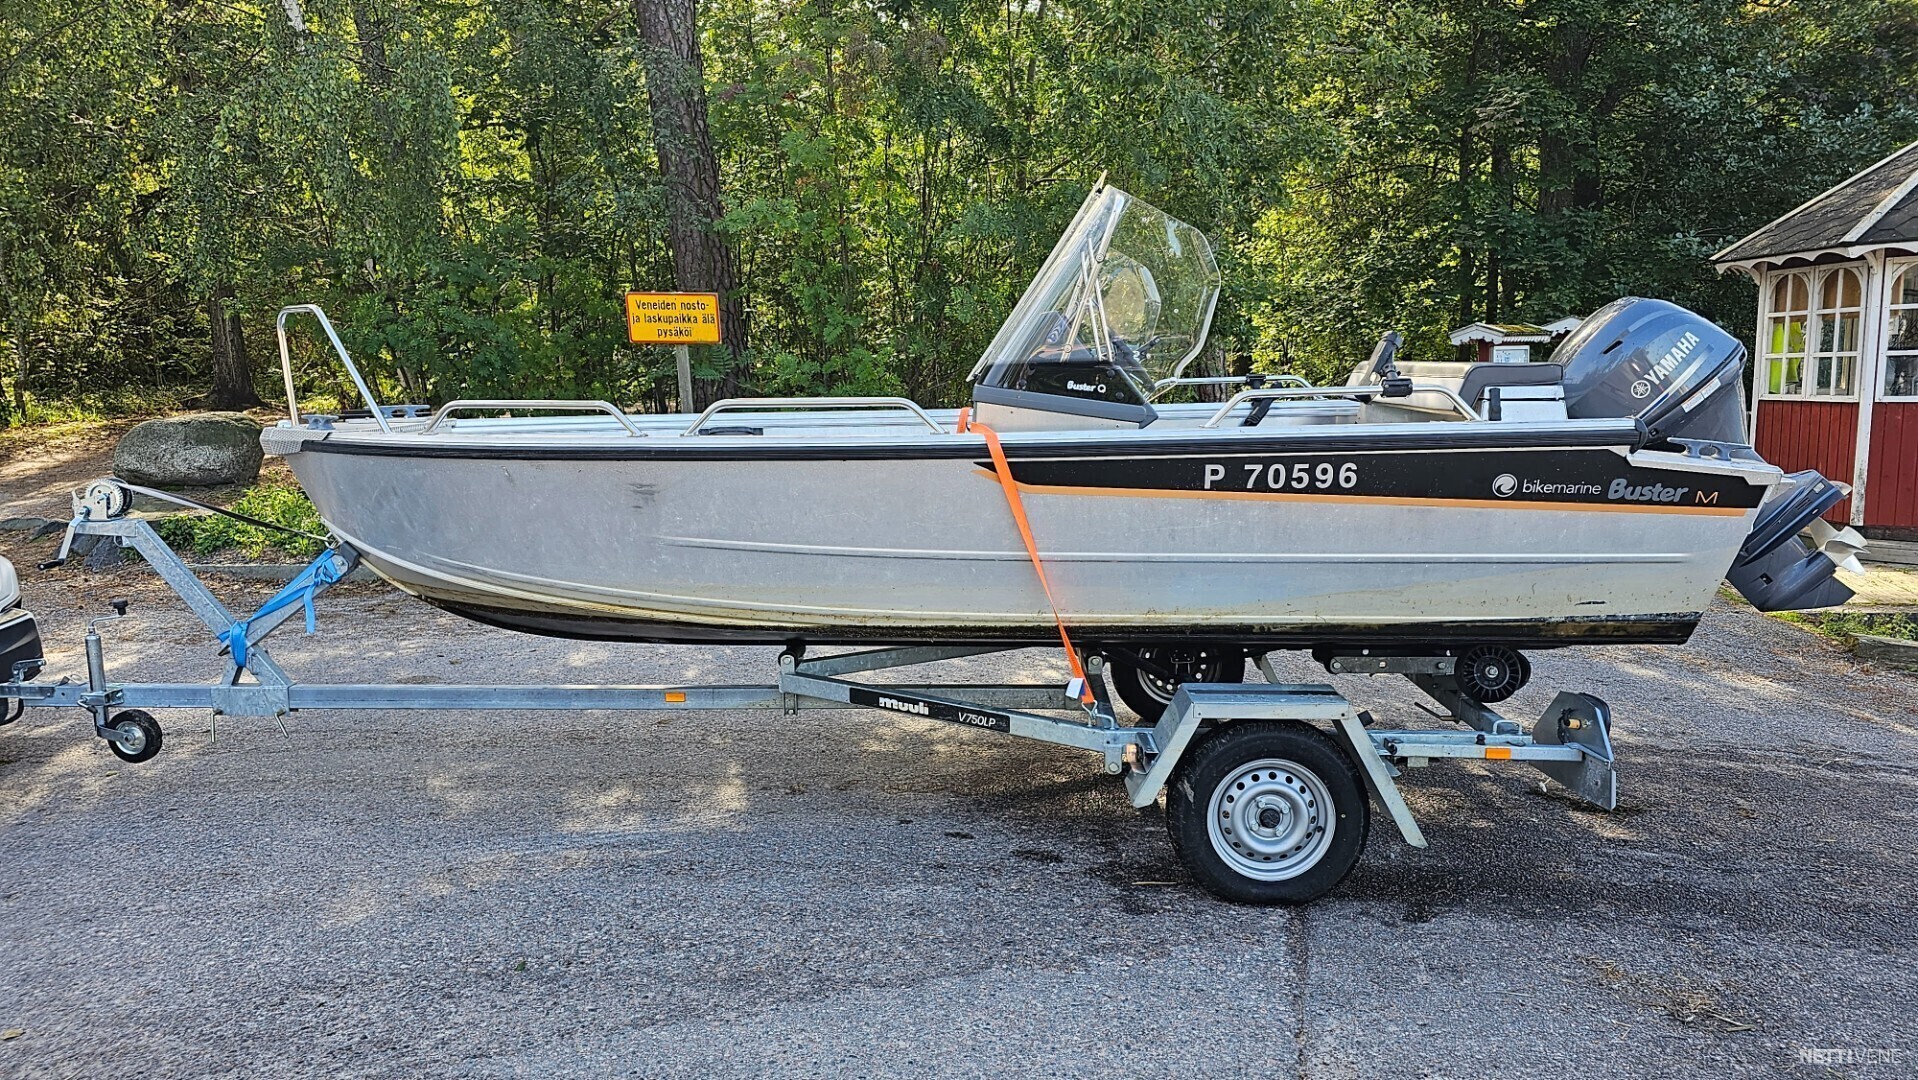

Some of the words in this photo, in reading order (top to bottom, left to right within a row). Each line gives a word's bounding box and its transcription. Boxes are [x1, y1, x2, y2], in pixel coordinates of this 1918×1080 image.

[635, 299, 677, 311] Veneiden
[680, 300, 710, 311] nosto-
[632, 313, 641, 324] ja
[644, 313, 698, 325] laskupaikka
[702, 313, 715, 324] älä
[657, 326, 692, 338] pysäköi
[1643, 331, 1700, 385] YAMAHA
[1066, 380, 1096, 392] Buster
[1204, 464, 1226, 490] P
[1244, 462, 1358, 489] 70596
[1522, 478, 1602, 495] bikemarine
[1607, 478, 1689, 503] Buster
[1694, 490, 1719, 505] M
[958, 711, 996, 728] V750LP
